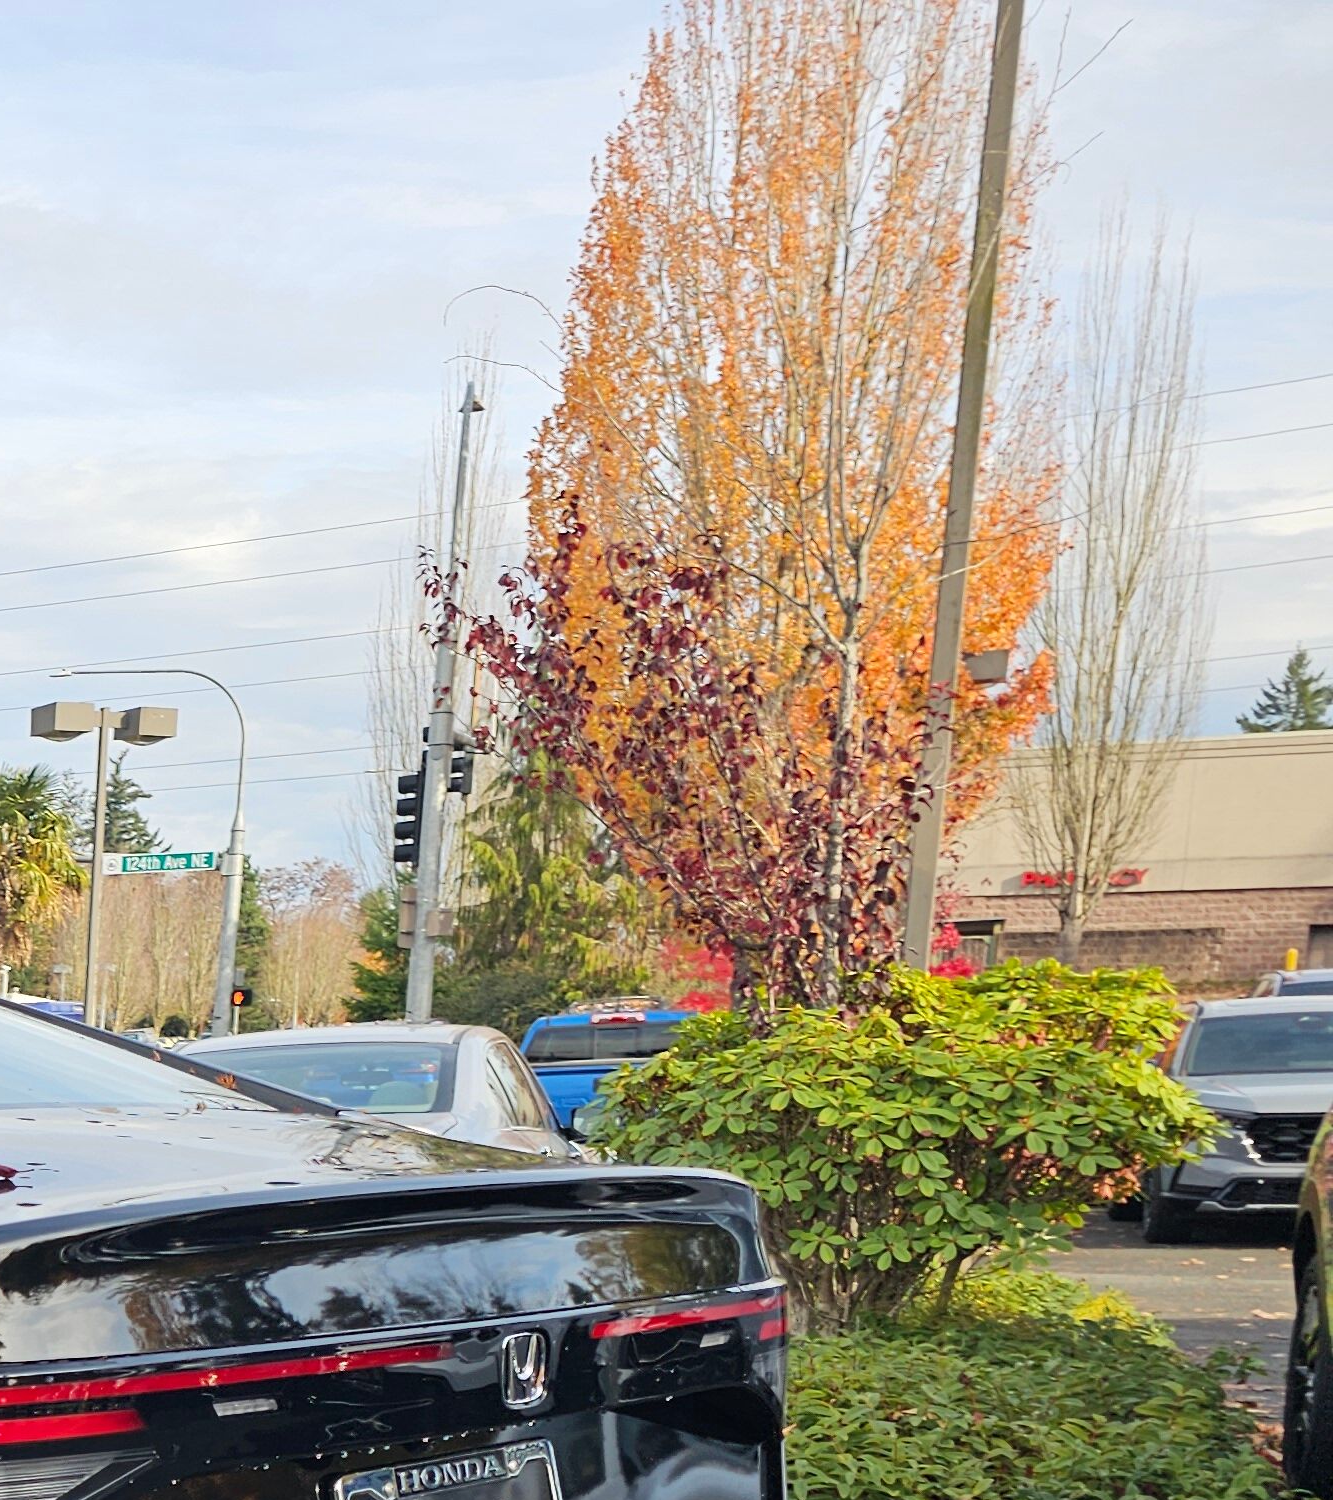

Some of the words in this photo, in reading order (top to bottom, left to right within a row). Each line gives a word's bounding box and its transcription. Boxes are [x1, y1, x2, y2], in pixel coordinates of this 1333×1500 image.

[126, 855, 161, 871] 124th
[163, 855, 187, 870] Ave
[191, 853, 210, 868] NE
[398, 1455, 507, 1493] HONDA
